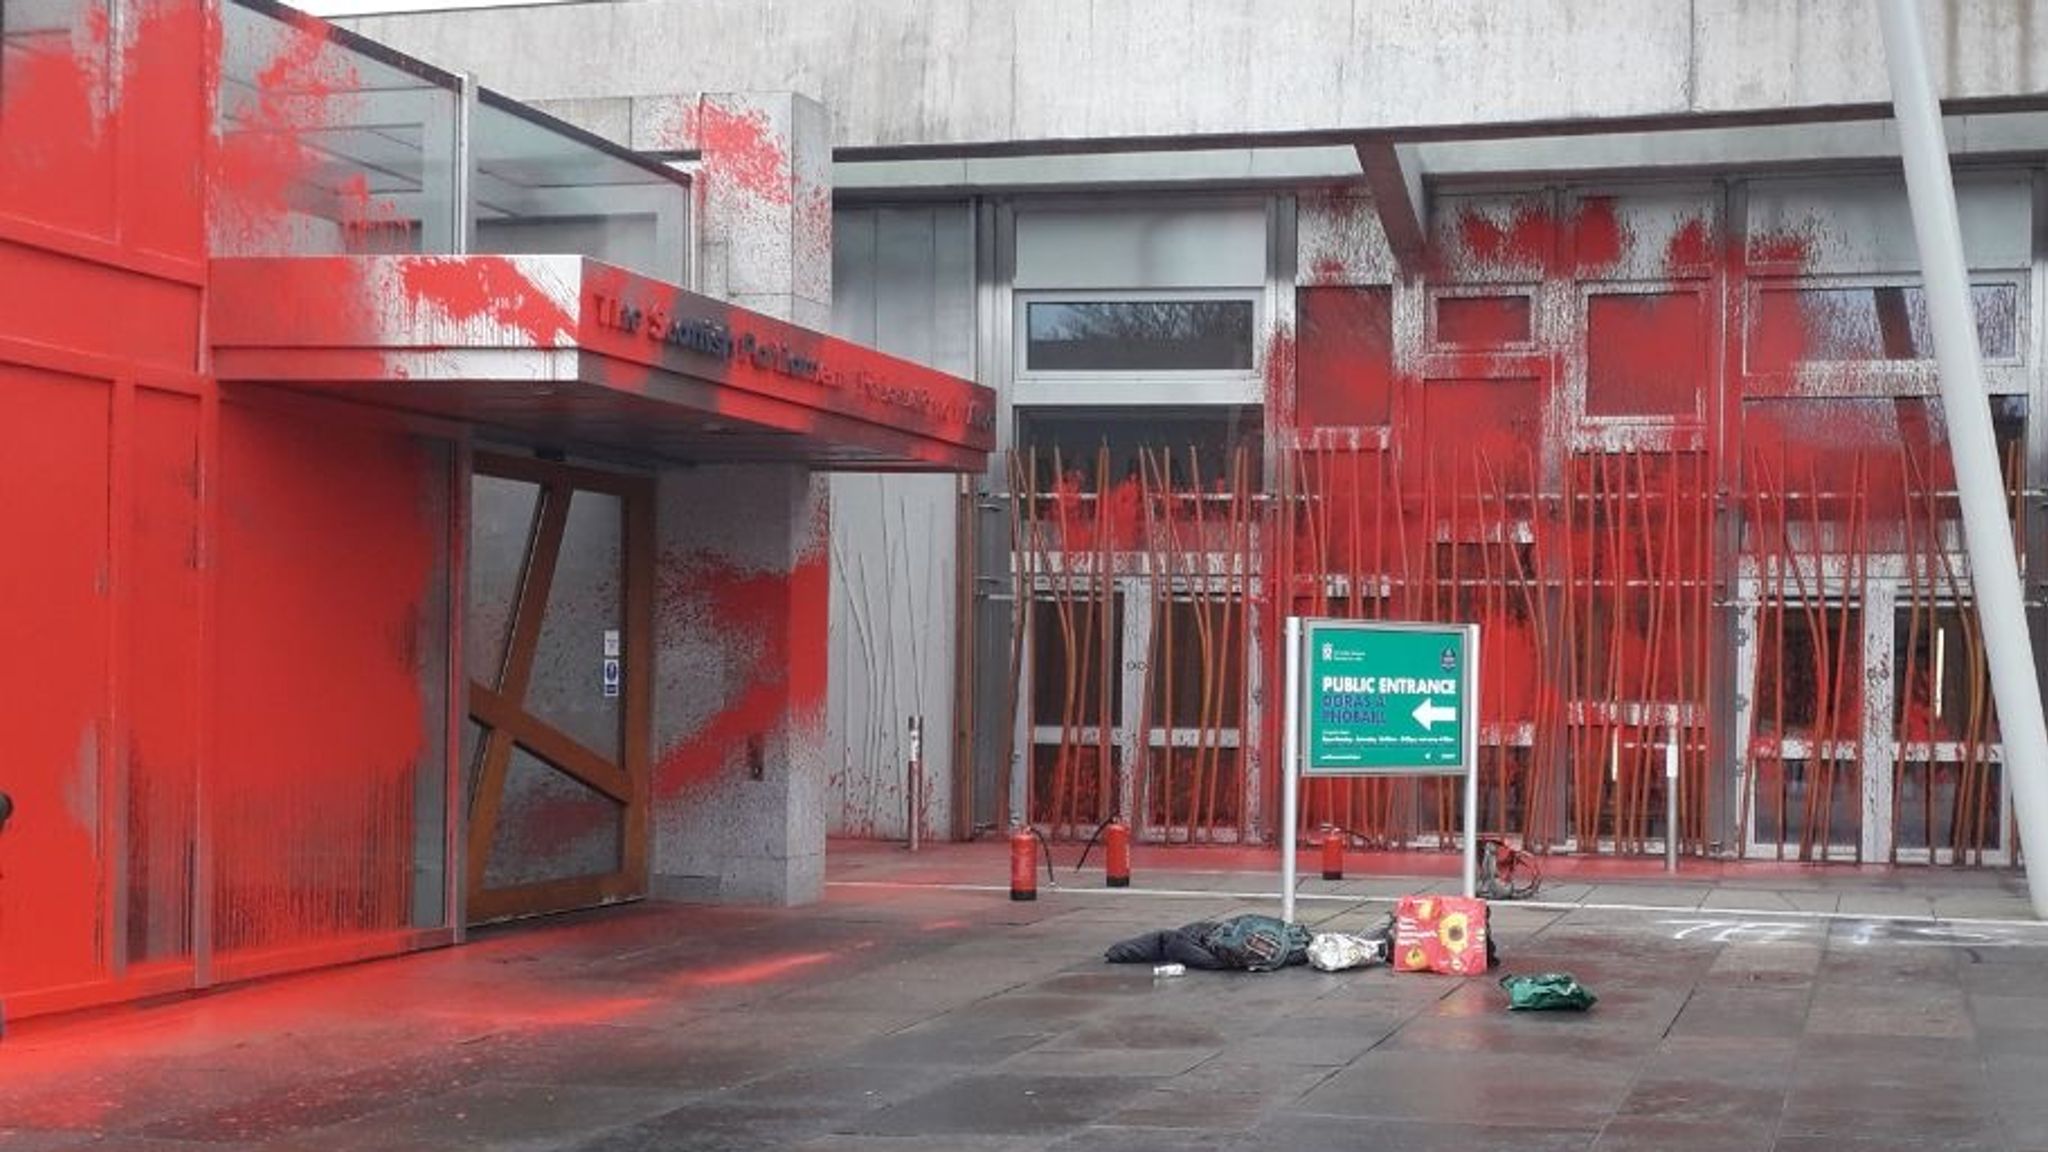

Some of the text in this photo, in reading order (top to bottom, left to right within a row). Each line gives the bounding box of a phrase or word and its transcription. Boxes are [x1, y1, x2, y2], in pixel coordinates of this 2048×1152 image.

[593, 295, 642, 334] The
[1322, 676, 1456, 694] PUBLIC ENTRANCE
